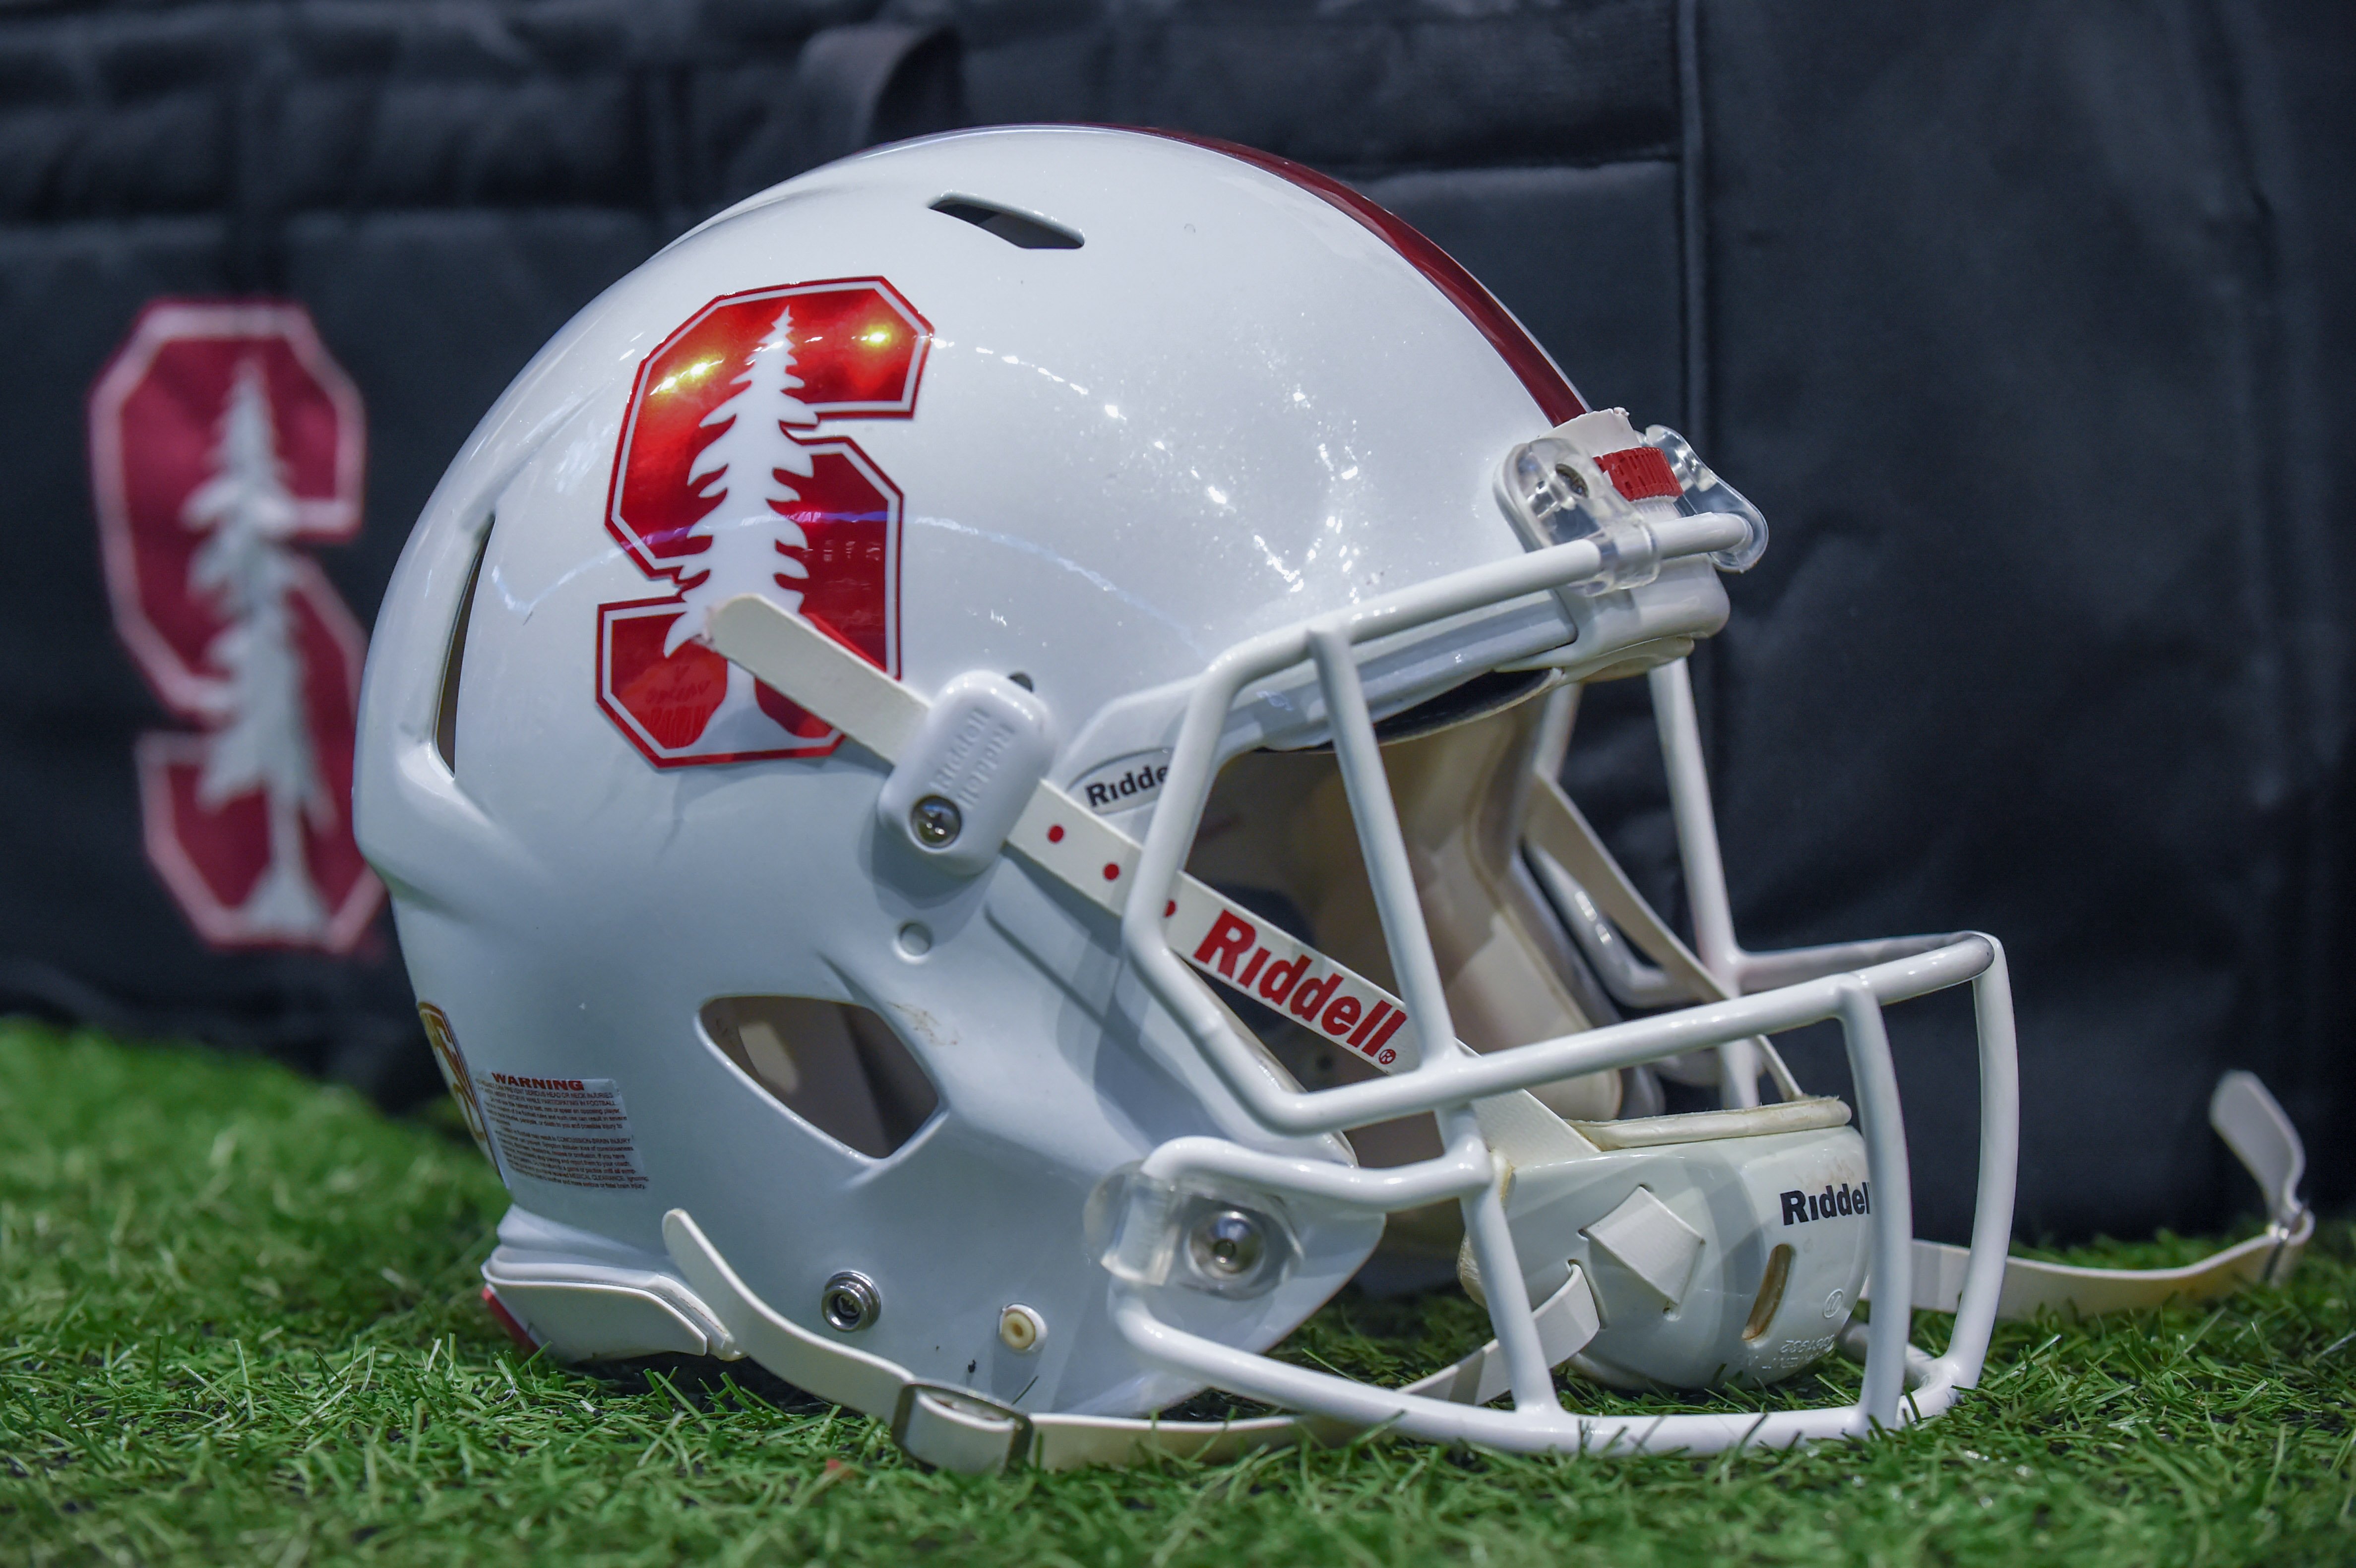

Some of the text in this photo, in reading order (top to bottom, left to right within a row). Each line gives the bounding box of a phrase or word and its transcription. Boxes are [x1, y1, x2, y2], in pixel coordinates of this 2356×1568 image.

[1086, 765, 1168, 807] Ridde
[492, 1072, 584, 1091] WARNING
[1780, 1182, 1870, 1226] Riddel
